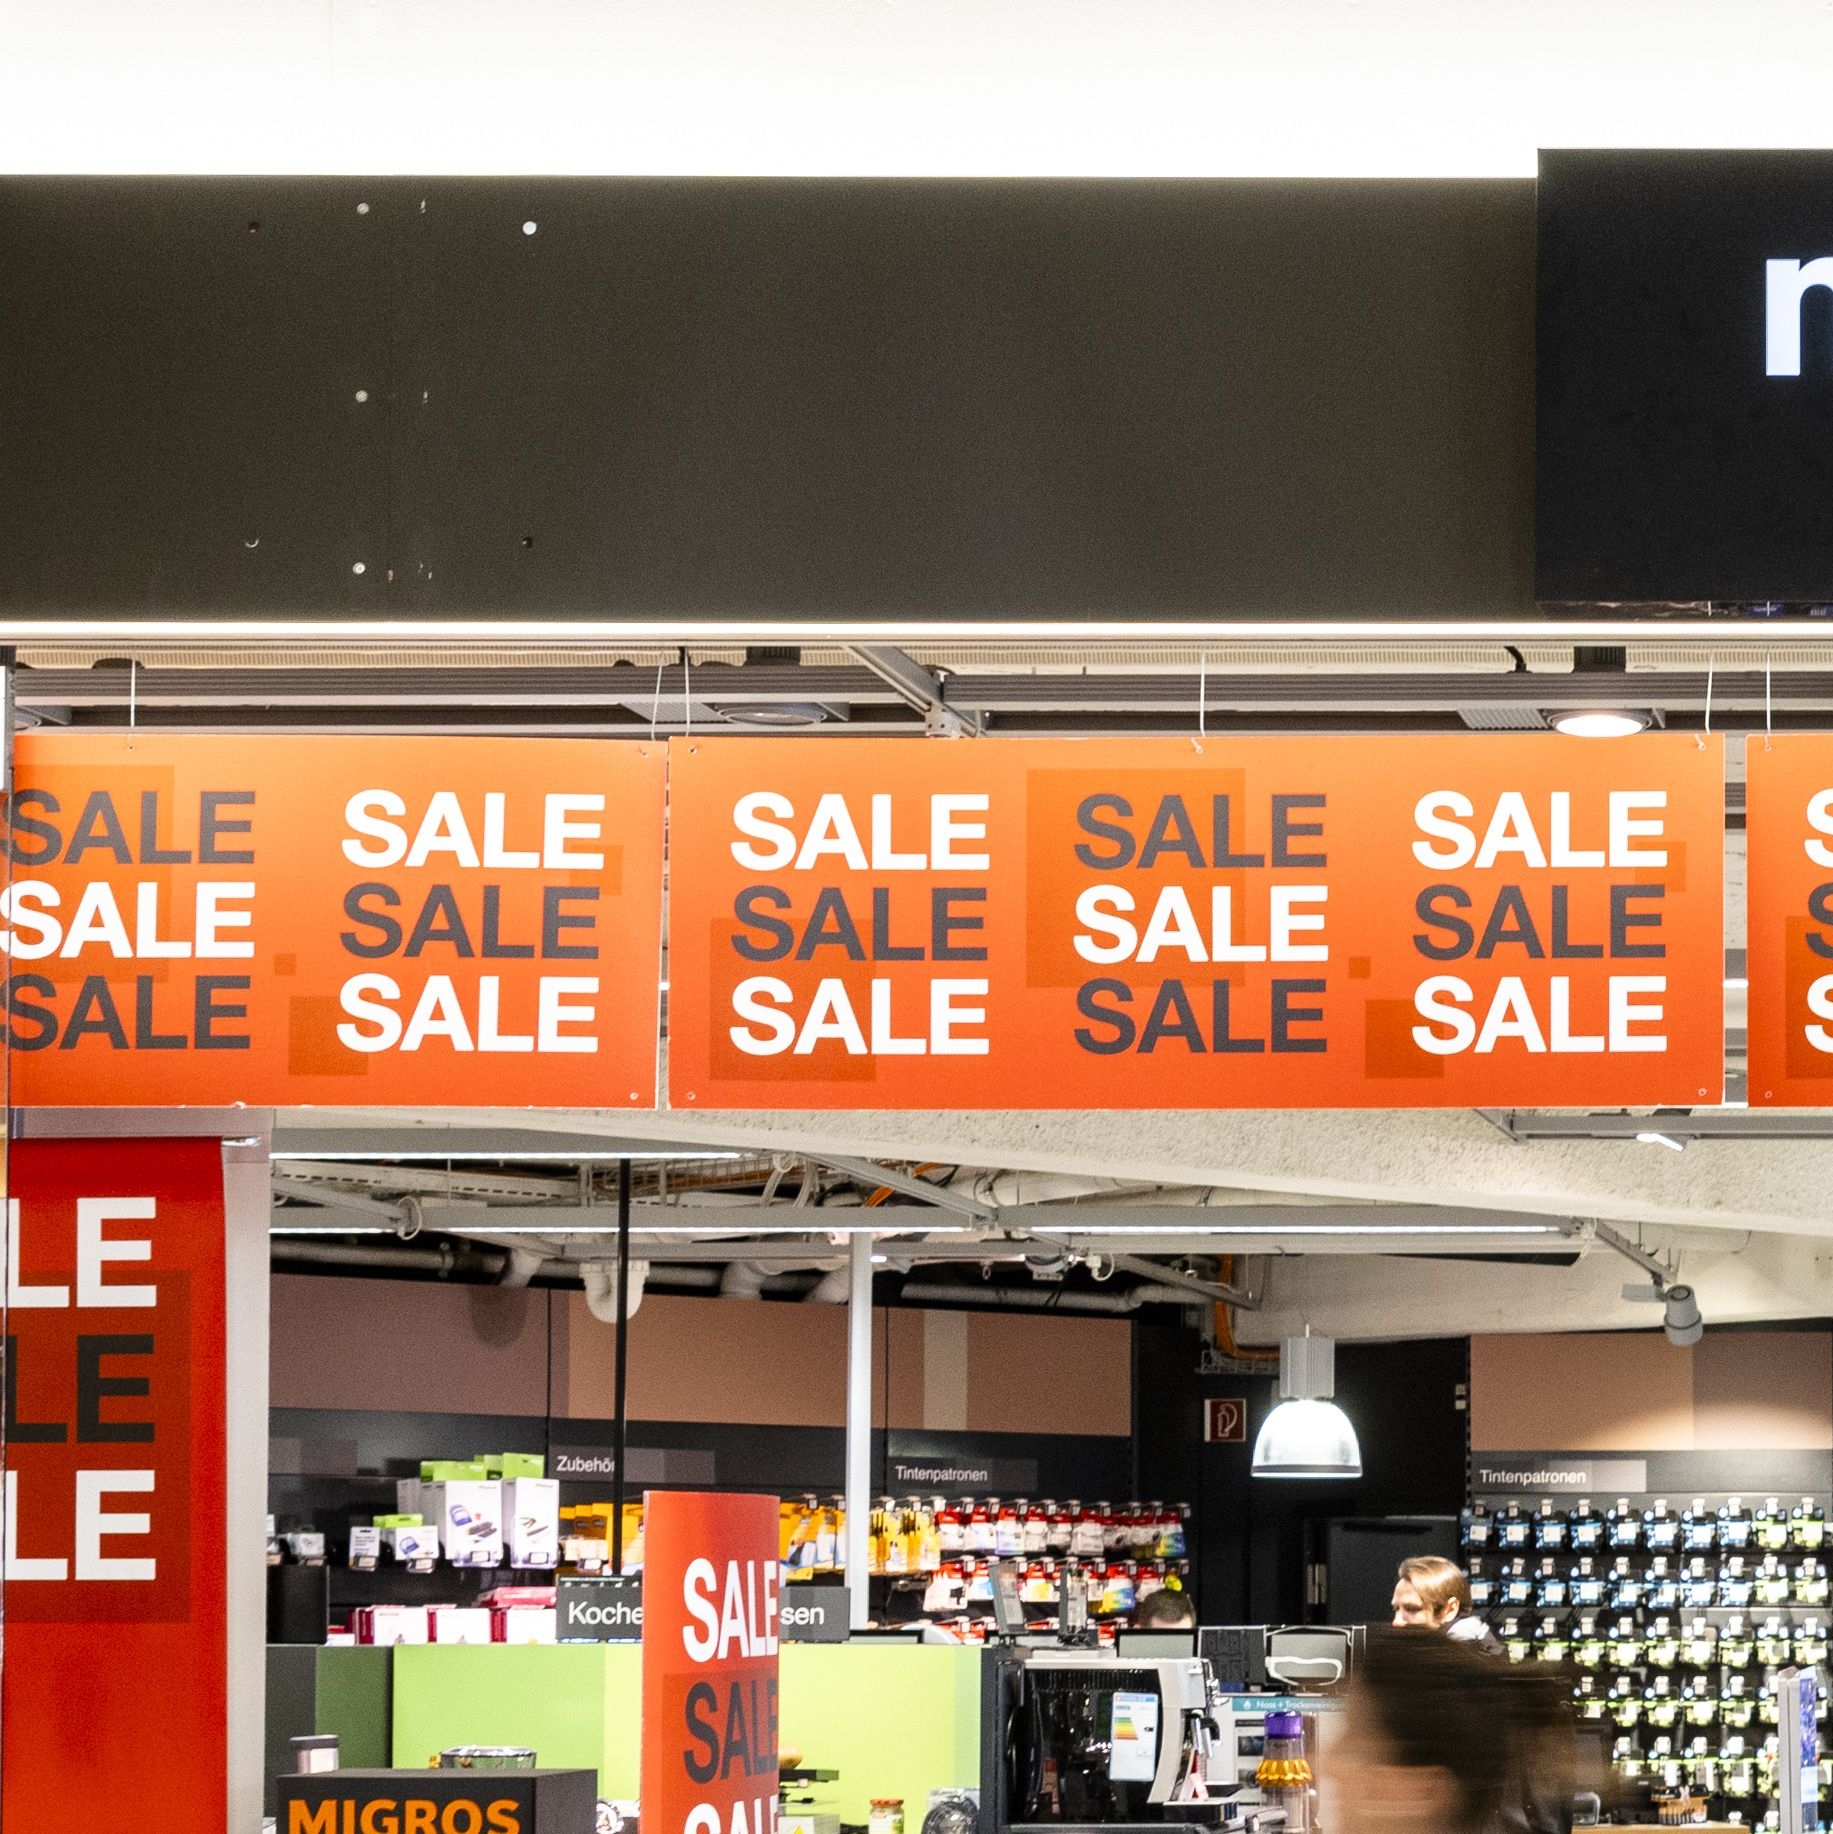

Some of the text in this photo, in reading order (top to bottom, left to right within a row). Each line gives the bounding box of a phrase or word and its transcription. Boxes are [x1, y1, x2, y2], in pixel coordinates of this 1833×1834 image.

[2, 789, 256, 866] SALE
[341, 788, 606, 870] SALE
[729, 791, 992, 871] SALE
[1072, 791, 1329, 870] SALE
[1410, 789, 1668, 870] SALE
[0, 879, 256, 960] SALE
[339, 882, 601, 961] SALE
[728, 884, 992, 963] SALE
[1073, 882, 1332, 964] SALE
[1411, 883, 1668, 962] SALE
[0, 974, 252, 1051] SALE
[336, 972, 599, 1054] SALE
[728, 976, 992, 1057] SALE
[1073, 976, 1330, 1056] SALE
[1410, 975, 1668, 1055] SALE
[895, 1465, 989, 1486] Tintenpatronen
[1479, 1466, 1587, 1488] Tintenpatronen
[681, 1558, 779, 1662] SALE
